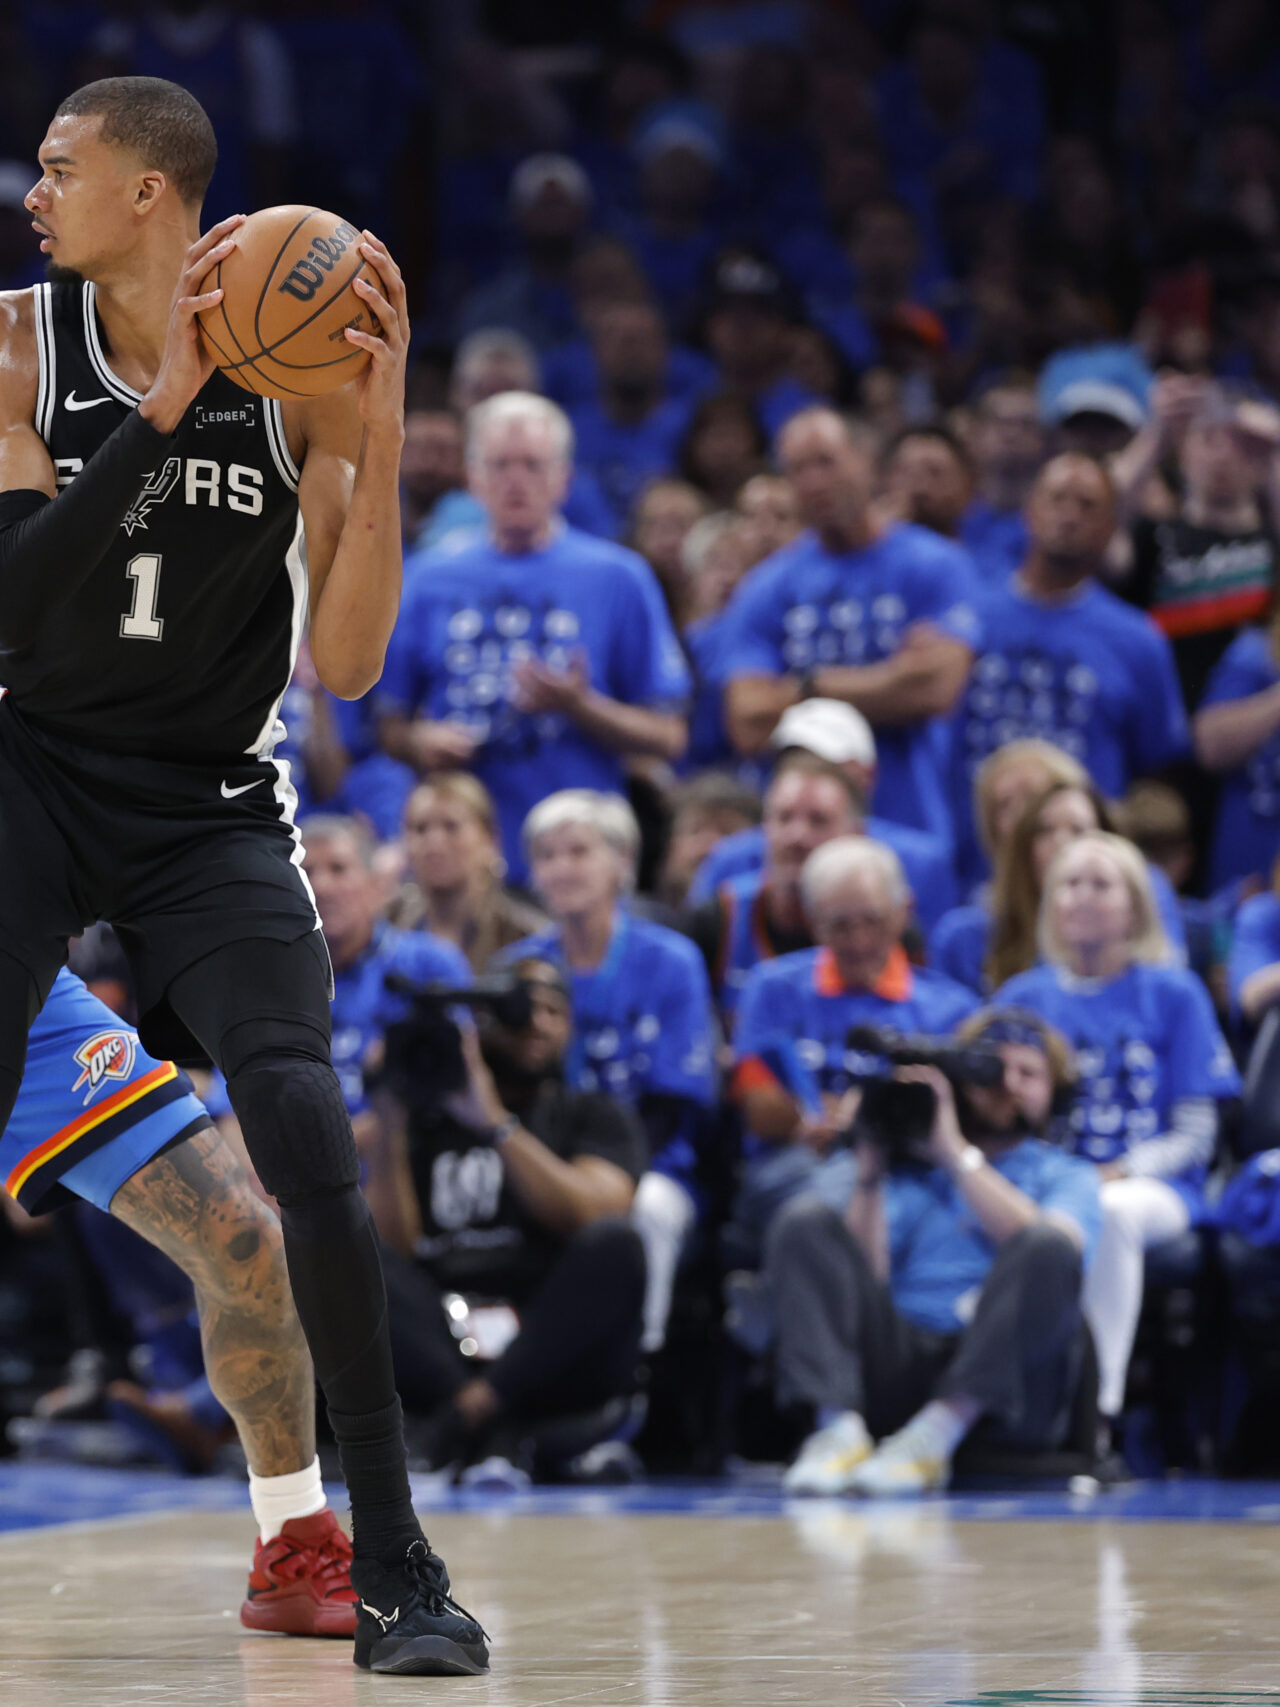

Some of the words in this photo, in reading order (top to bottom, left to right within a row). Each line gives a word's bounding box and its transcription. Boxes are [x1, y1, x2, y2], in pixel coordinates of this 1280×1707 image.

[277, 219, 362, 302] Wilson
[201, 410, 247, 423] LEDGER
[119, 553, 164, 642] 1
[89, 1037, 122, 1086] OKC
